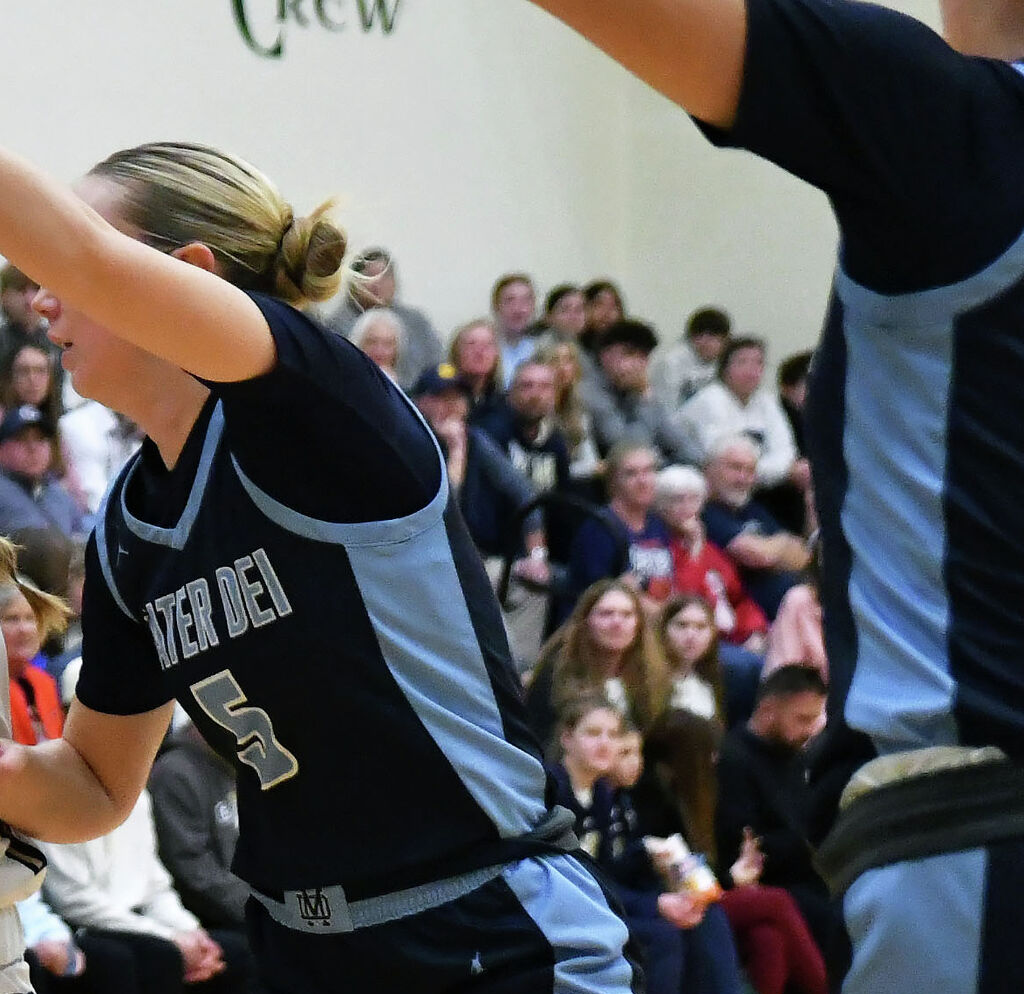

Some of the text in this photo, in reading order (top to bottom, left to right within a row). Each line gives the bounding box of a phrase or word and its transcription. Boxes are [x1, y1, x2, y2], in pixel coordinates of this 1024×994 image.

[144, 548, 293, 671] ATER DEI
[189, 669, 299, 791] 5
